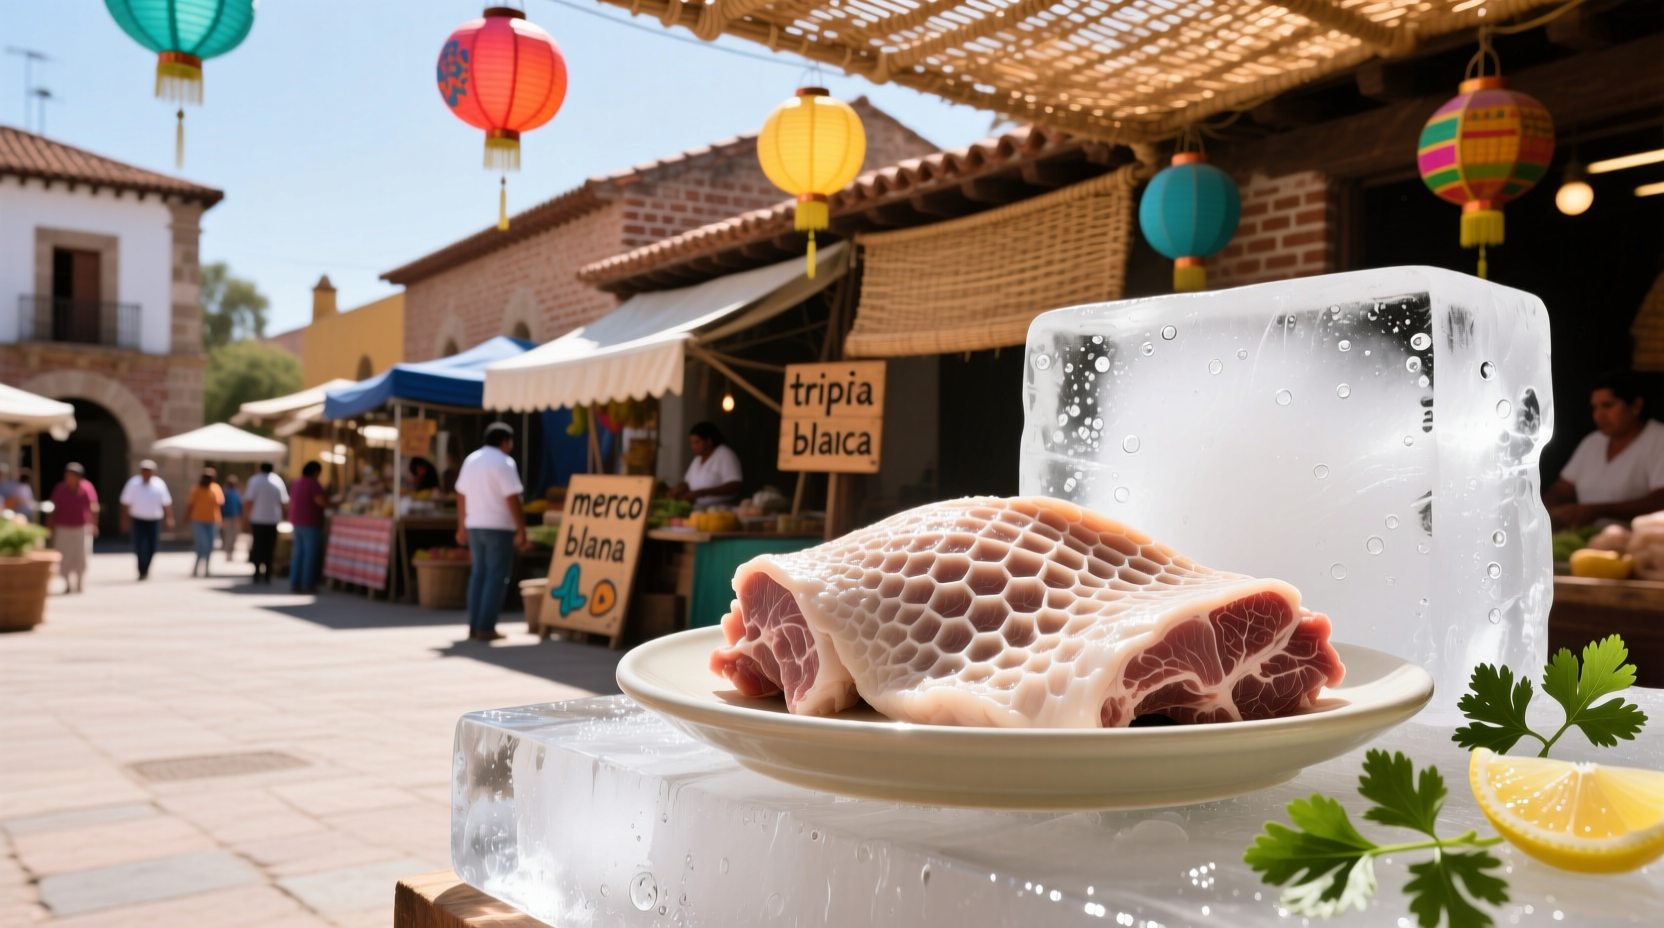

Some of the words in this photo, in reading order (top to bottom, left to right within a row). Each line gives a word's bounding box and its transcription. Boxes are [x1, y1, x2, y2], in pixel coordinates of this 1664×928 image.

[789, 371, 873, 417] tripia
[570, 492, 643, 520] merco
[564, 524, 625, 563] blana
